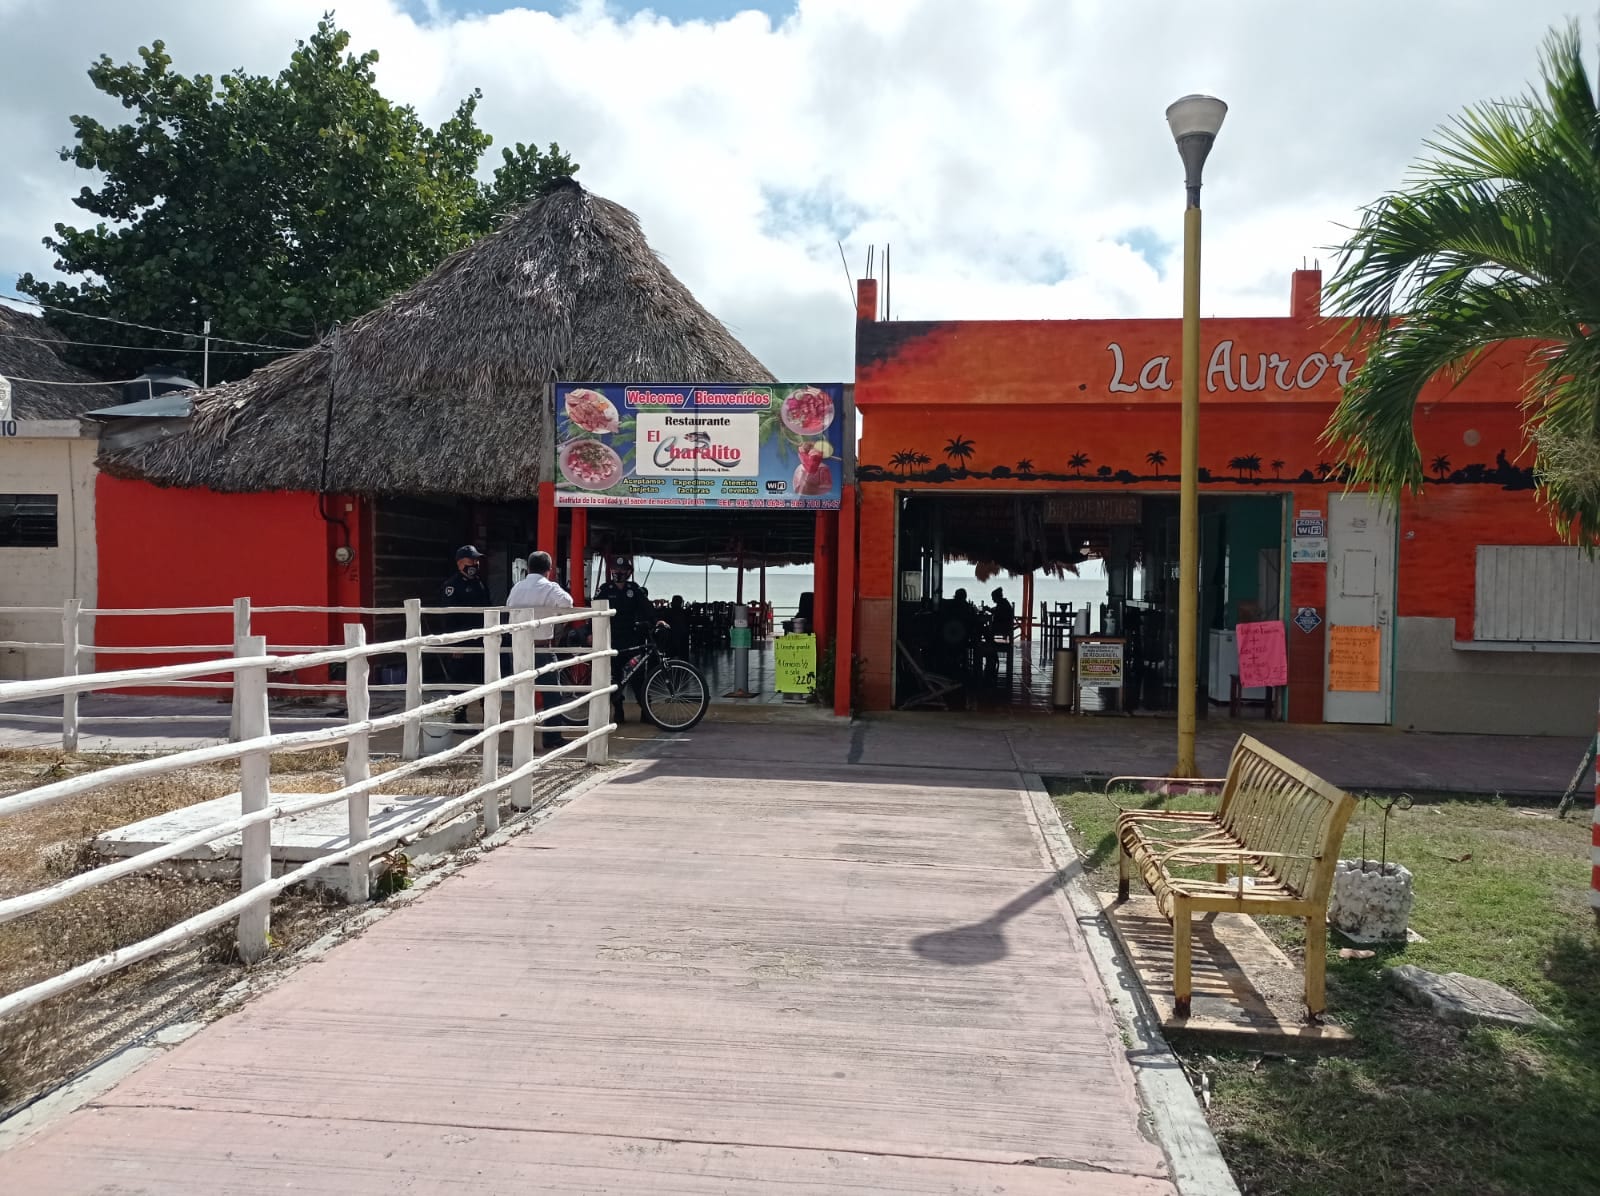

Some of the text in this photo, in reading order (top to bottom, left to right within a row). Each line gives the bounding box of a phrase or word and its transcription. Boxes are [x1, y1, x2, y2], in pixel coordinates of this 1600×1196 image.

[1106, 340, 1355, 393] La Auror
[626, 390, 770, 405] Welcome Bienvenidos
[665, 416, 731, 426] Restaurante
[647, 430, 660, 443] El
[623, 478, 666, 487] Aceptamos
[673, 479, 715, 488] Expedimos
[629, 485, 659, 495] tarjetas
[677, 487, 710, 496] facturas
[728, 487, 759, 496] eventos
